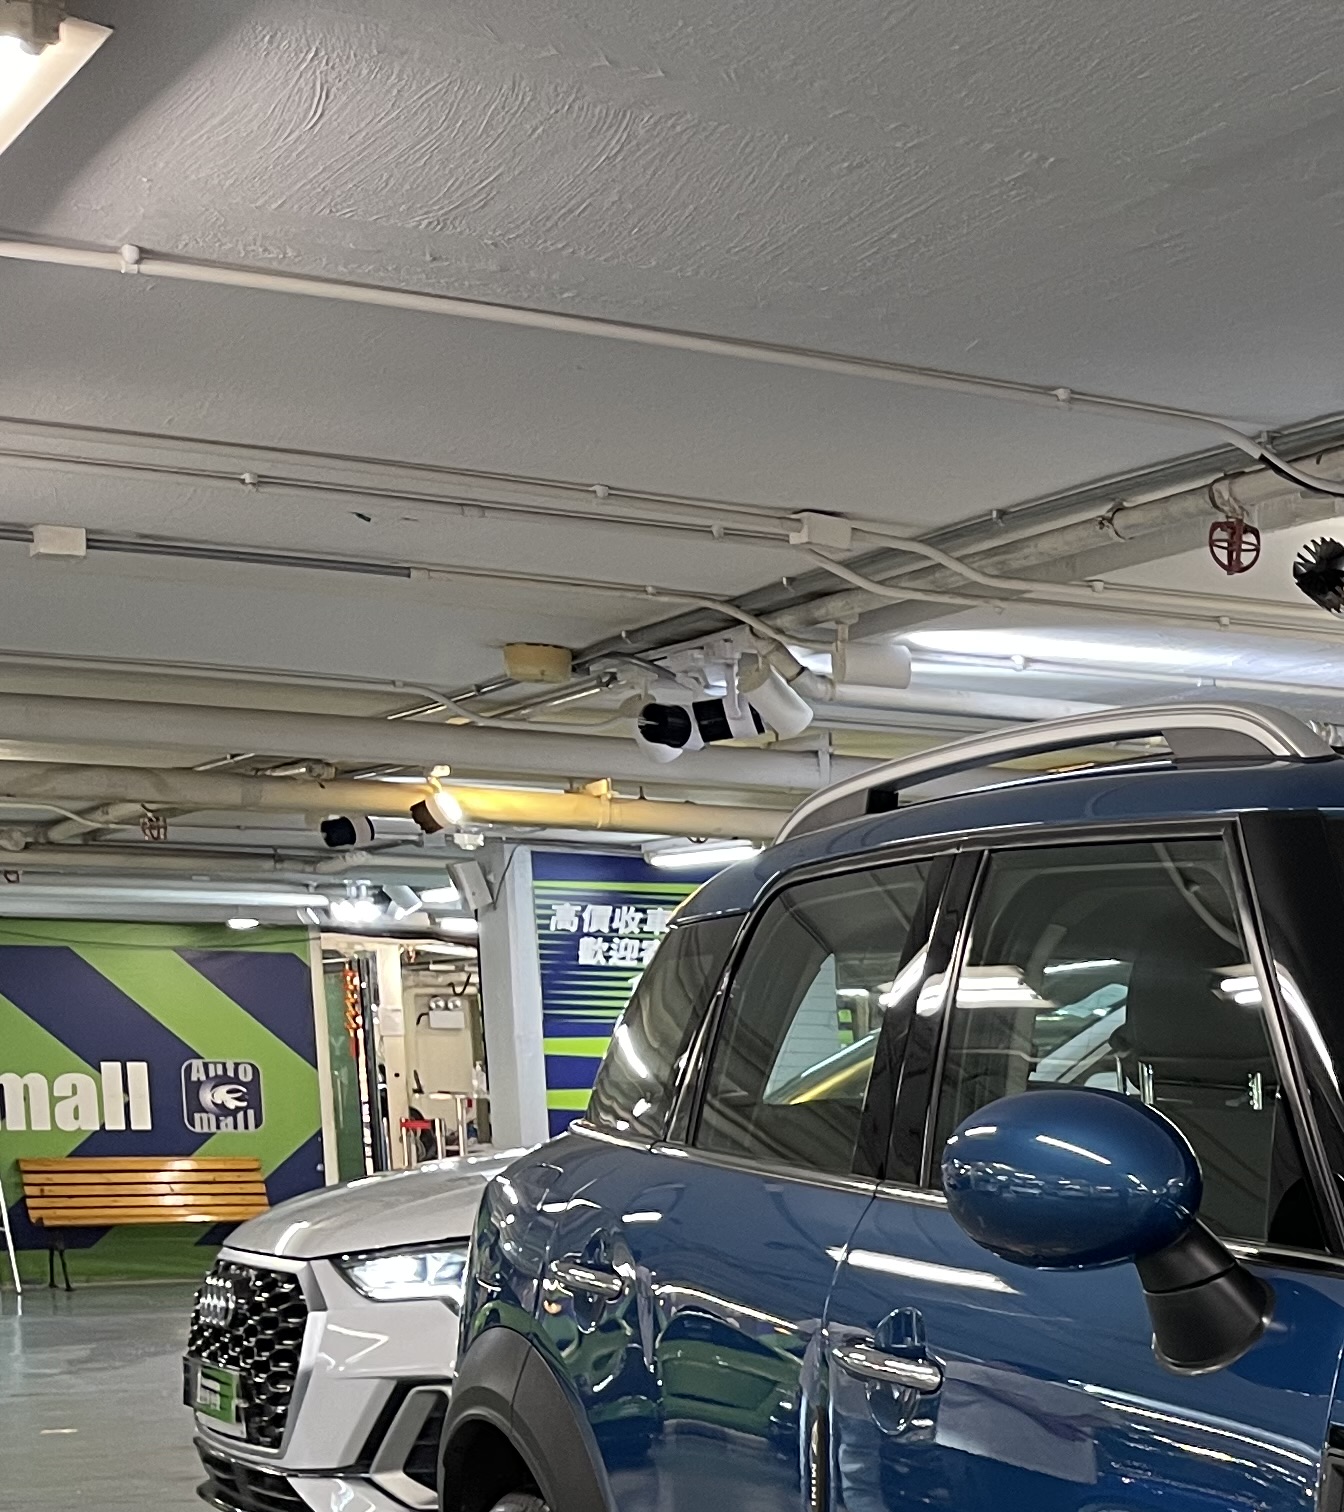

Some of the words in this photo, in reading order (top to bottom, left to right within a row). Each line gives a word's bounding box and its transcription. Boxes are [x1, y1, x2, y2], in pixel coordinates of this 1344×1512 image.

[550, 903, 673, 935] 高價收車
[191, 1060, 252, 1082] Auto
[0, 1061, 152, 1131] mall
[194, 1109, 256, 1132] mall
